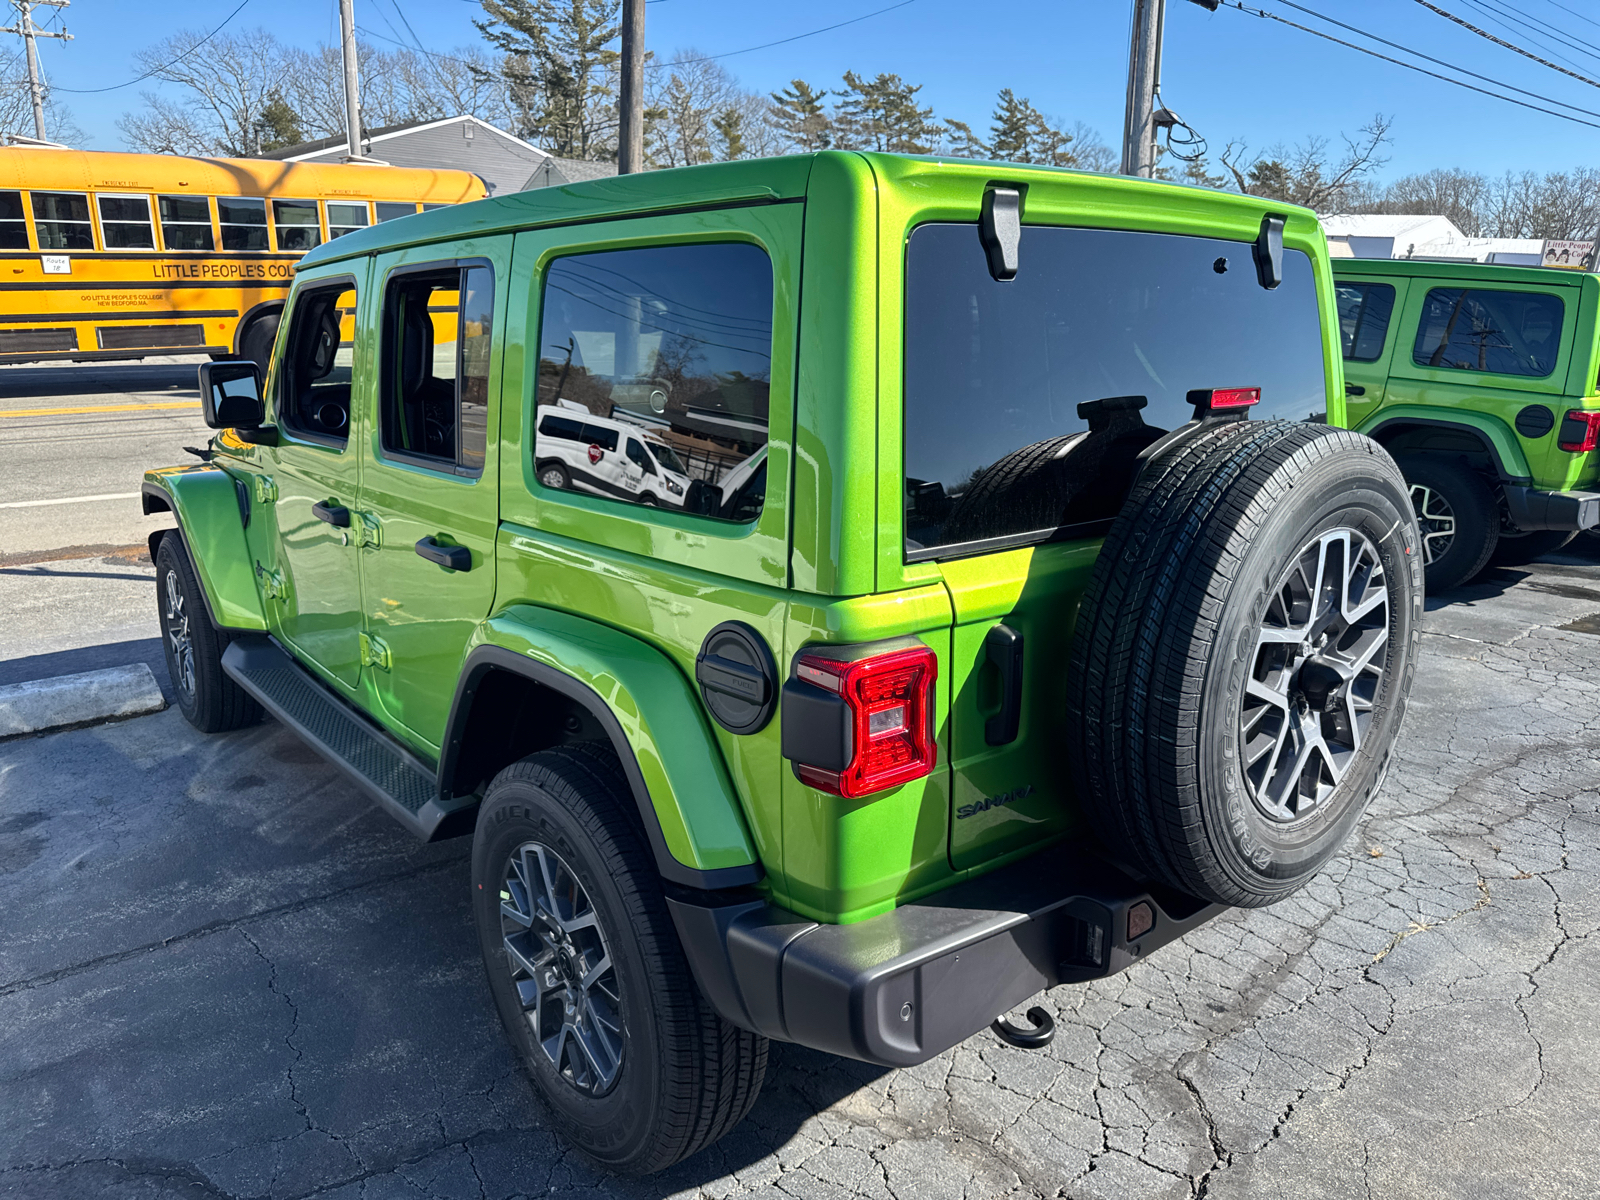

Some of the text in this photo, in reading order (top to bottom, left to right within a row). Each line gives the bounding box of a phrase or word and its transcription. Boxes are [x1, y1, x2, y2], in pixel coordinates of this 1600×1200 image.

[1547, 241, 1567, 249] Little
[153, 265, 199, 278] LITTLE
[202, 265, 266, 278] PEOPLE'S
[732, 678, 753, 691] FUEL
[956, 784, 1036, 820] SAHARA
